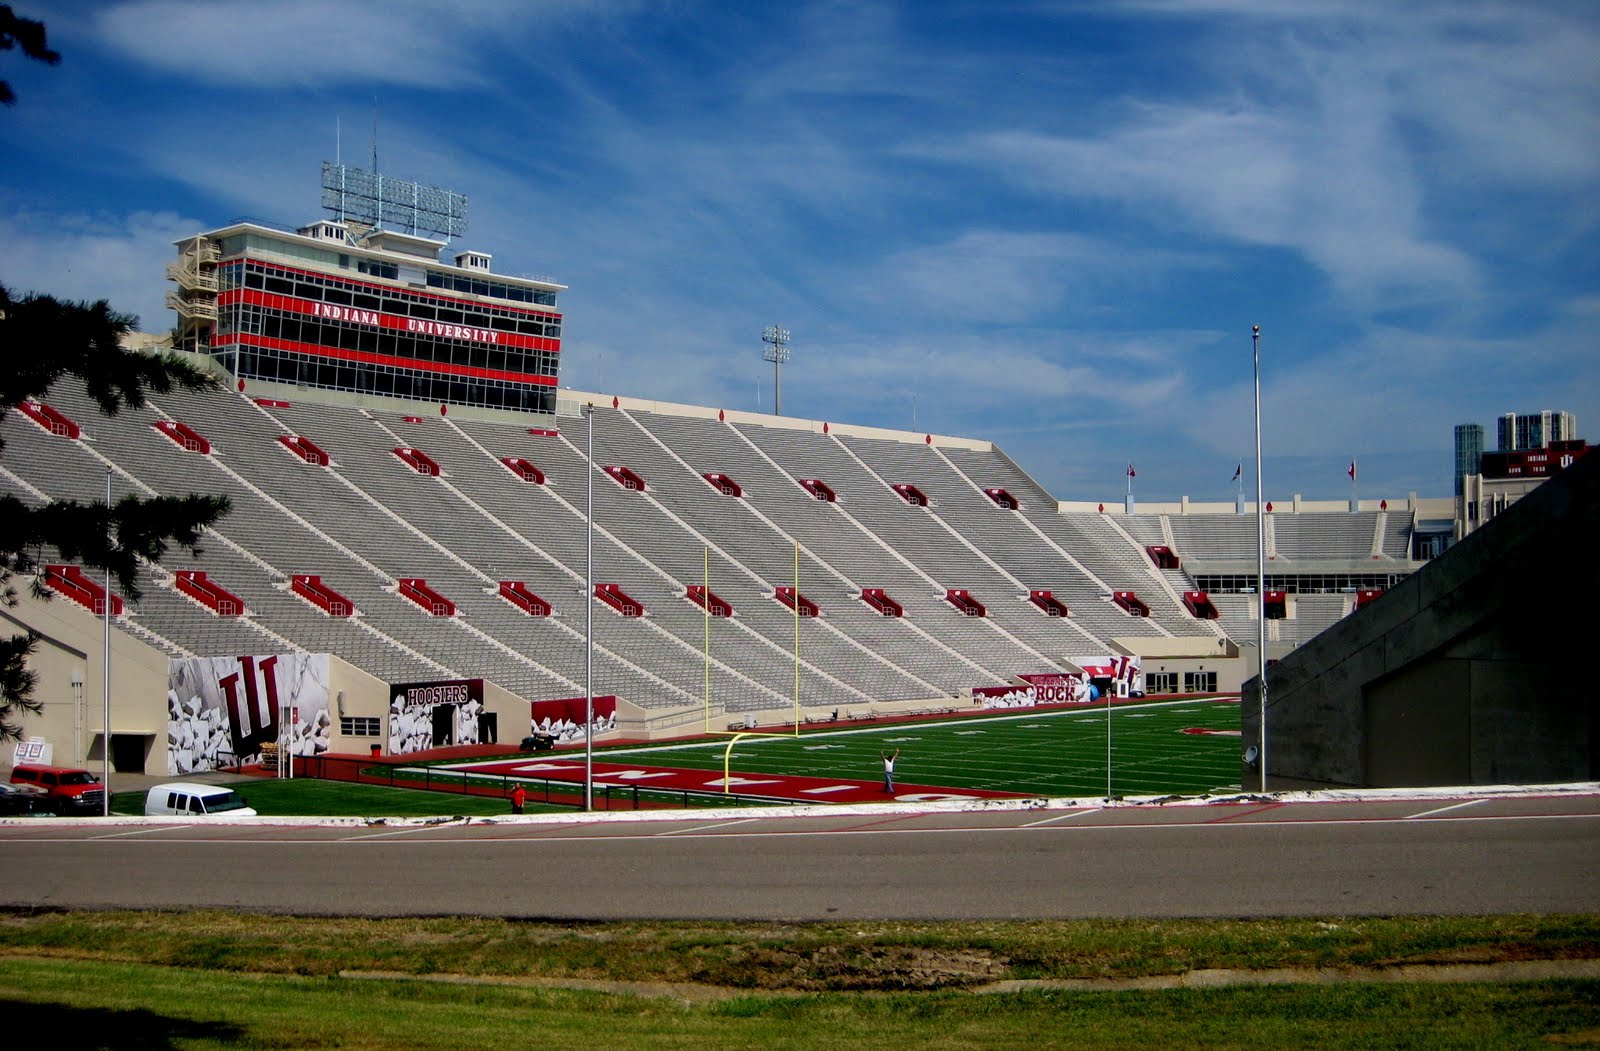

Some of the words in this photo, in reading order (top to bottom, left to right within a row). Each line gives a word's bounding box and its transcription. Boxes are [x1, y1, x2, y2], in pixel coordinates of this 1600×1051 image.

[313, 303, 379, 325] INDIANA
[408, 319, 498, 343] UNIVERSITY
[1030, 676, 1065, 686] WELCOME
[1065, 677, 1077, 686] TO
[408, 685, 469, 707] HOOSIERS
[1035, 685, 1076, 702] ROCK
